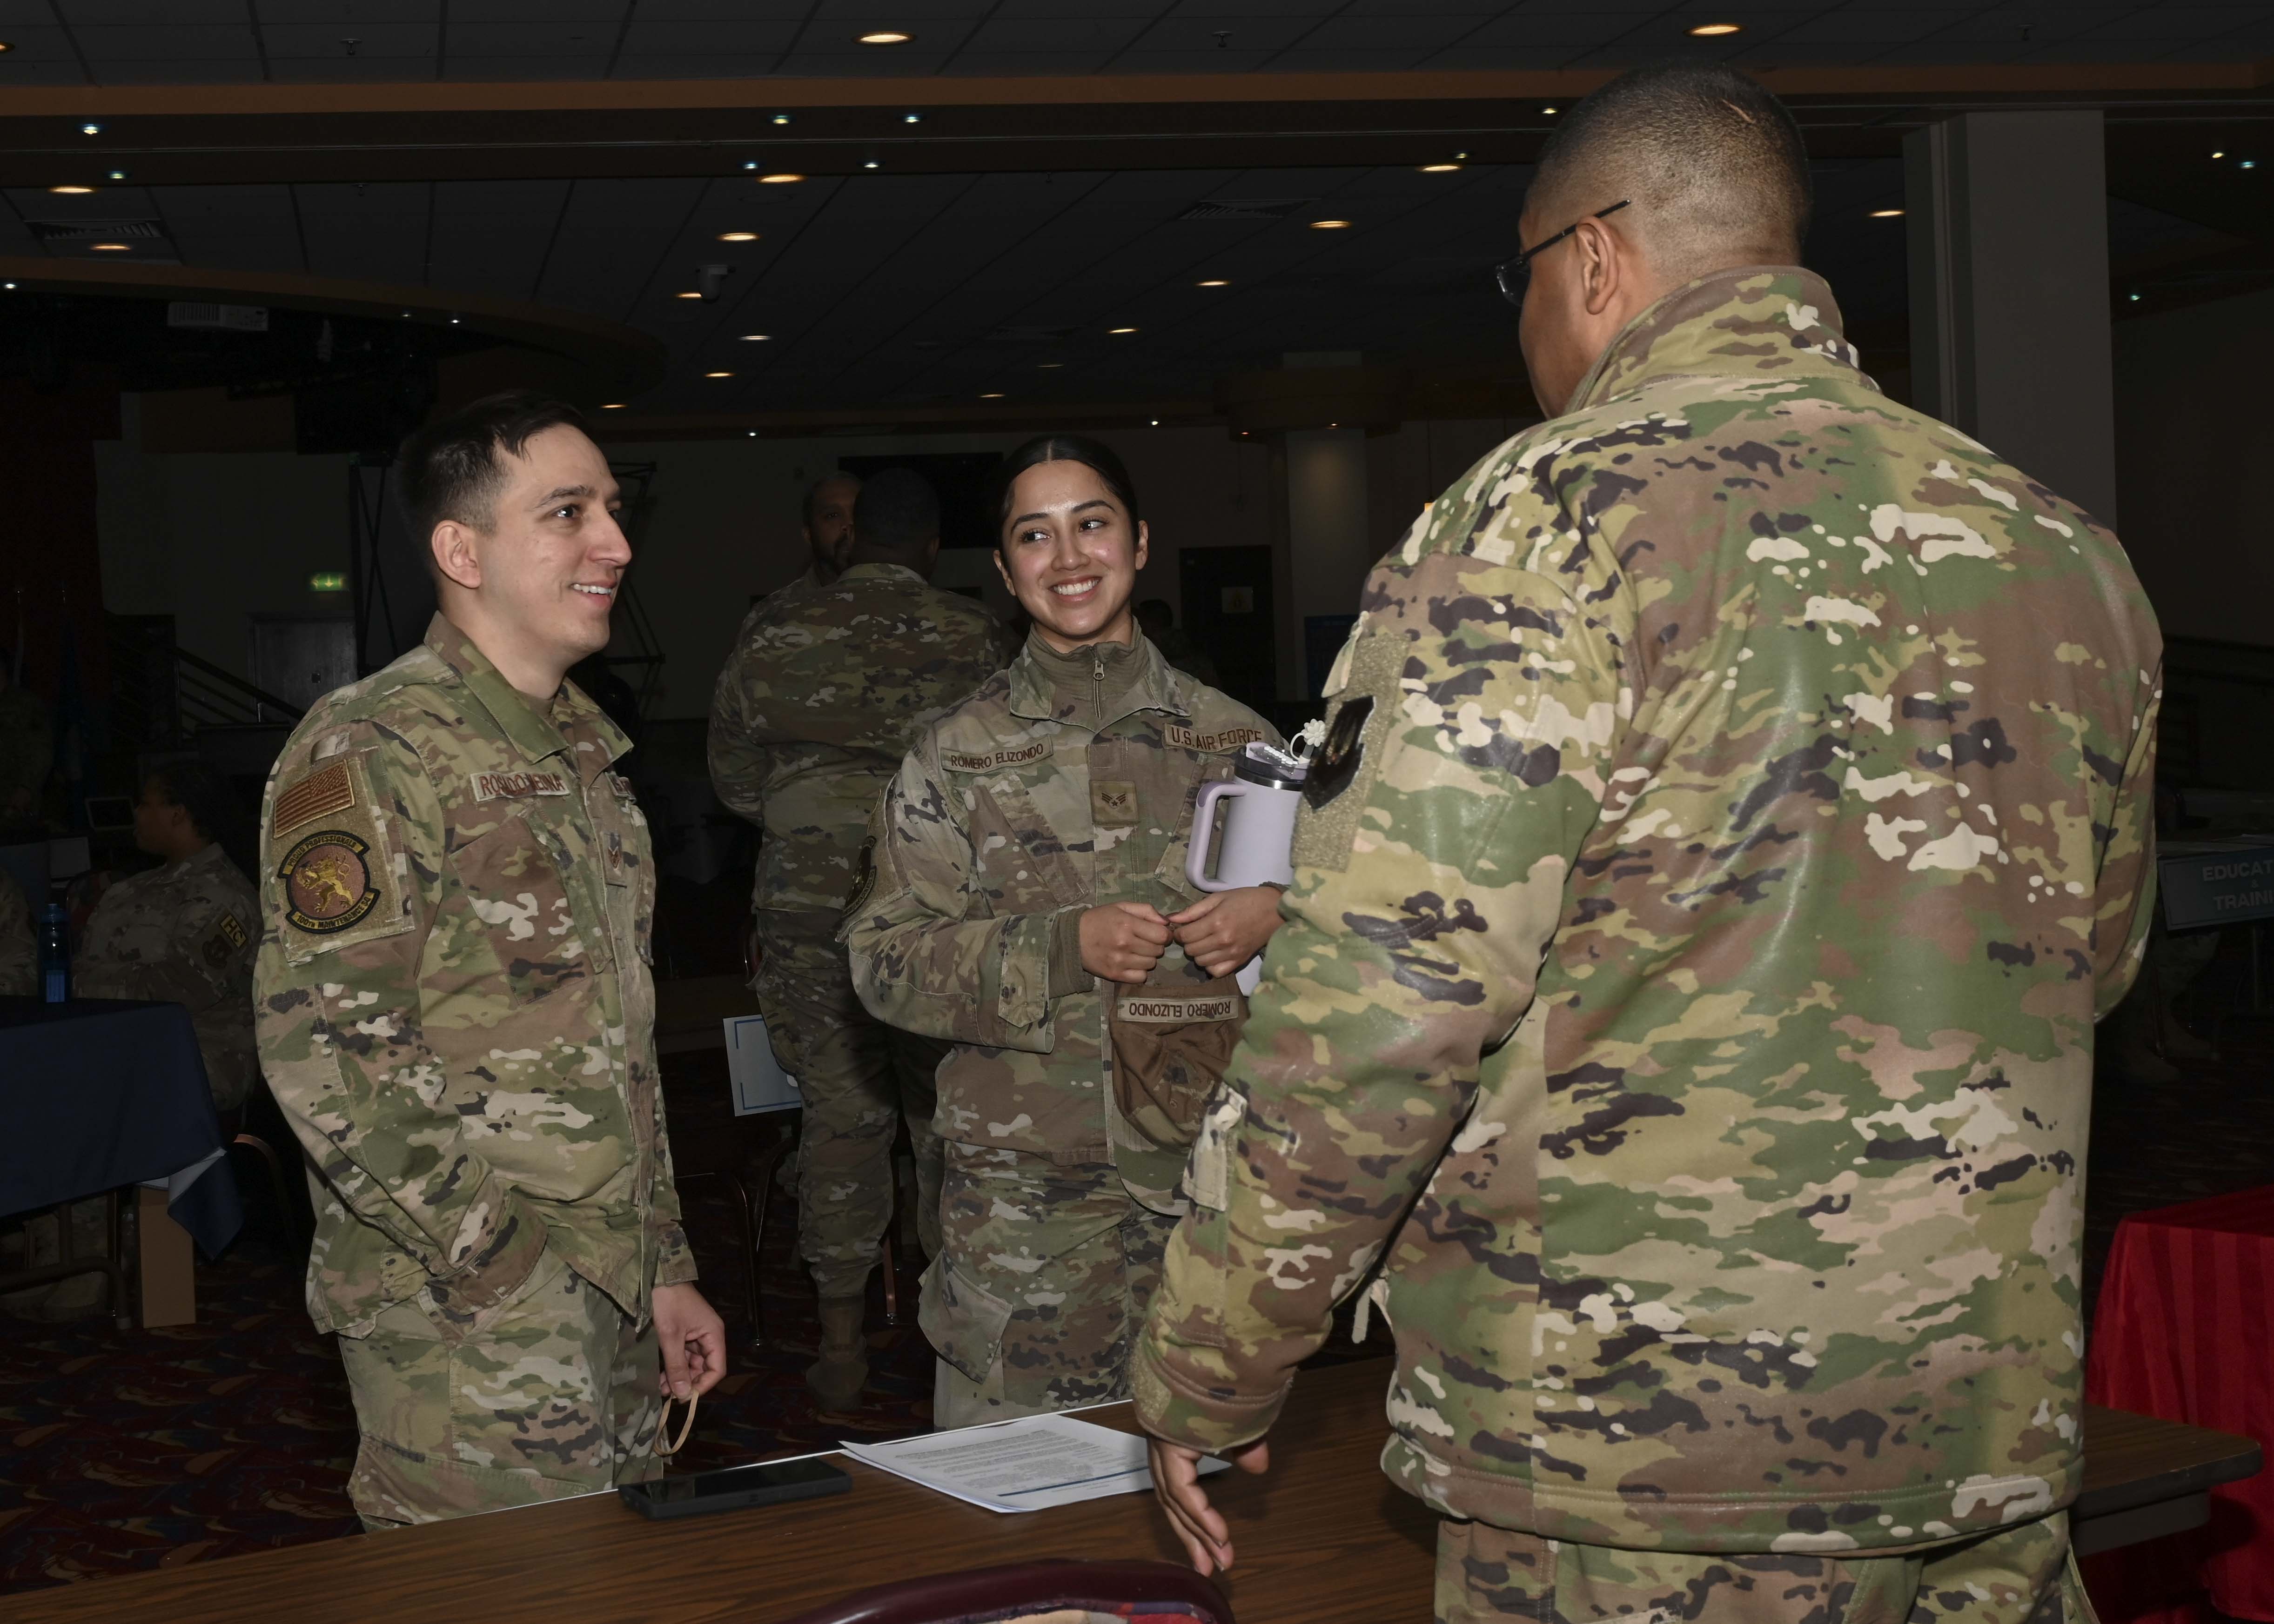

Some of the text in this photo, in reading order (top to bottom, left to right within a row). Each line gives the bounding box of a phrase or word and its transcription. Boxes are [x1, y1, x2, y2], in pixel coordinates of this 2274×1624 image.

[1171, 727, 1262, 750] U.S. AIR FORCE
[951, 743, 1043, 769] ROMERO ELIZONDO
[287, 835, 357, 866] PROUD PROFESSIONALS
[2202, 860, 2274, 881] EDUCAT
[2252, 879, 2259, 888] &
[2212, 889, 2274, 910] TRAINI
[317, 905, 363, 928] MAINTENANCE
[361, 896, 371, 908] SQ
[1129, 1001, 1231, 1019] ROMERO ELIZONDO
